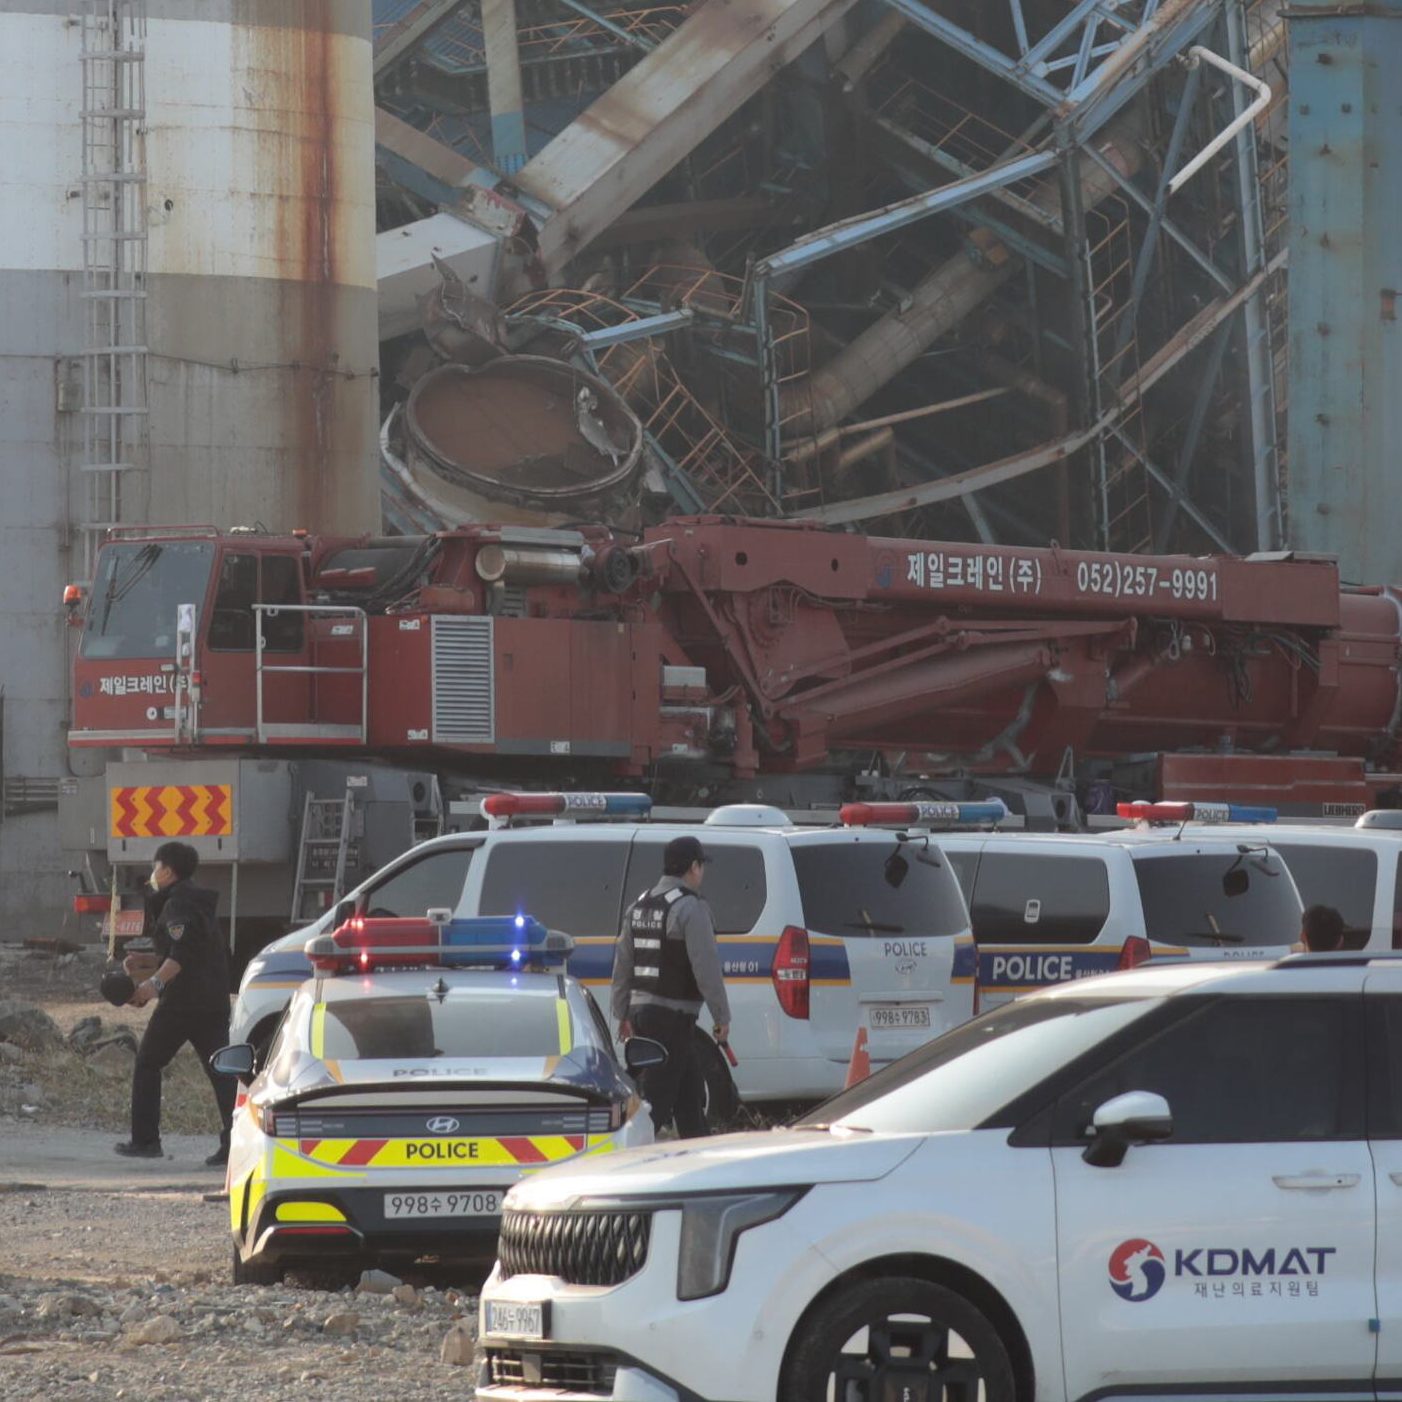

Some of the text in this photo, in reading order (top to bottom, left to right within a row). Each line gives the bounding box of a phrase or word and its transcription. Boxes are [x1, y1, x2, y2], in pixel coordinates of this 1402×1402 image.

[1077, 561, 1218, 601] 052)257-9991
[569, 794, 605, 808] POLICE
[1197, 808, 1228, 821] POLICE
[631, 919, 662, 929] POLICE
[884, 942, 928, 958] POLICE
[992, 956, 1073, 981] POLICE
[902, 1009, 927, 1025] 9783
[392, 1066, 488, 1078] POLICE
[405, 1141, 480, 1160] POLICE
[391, 1193, 497, 1215] 998수 9708
[1174, 1247, 1337, 1276] KDMAT
[1194, 1281, 1319, 1298] 재난의료지원팀
